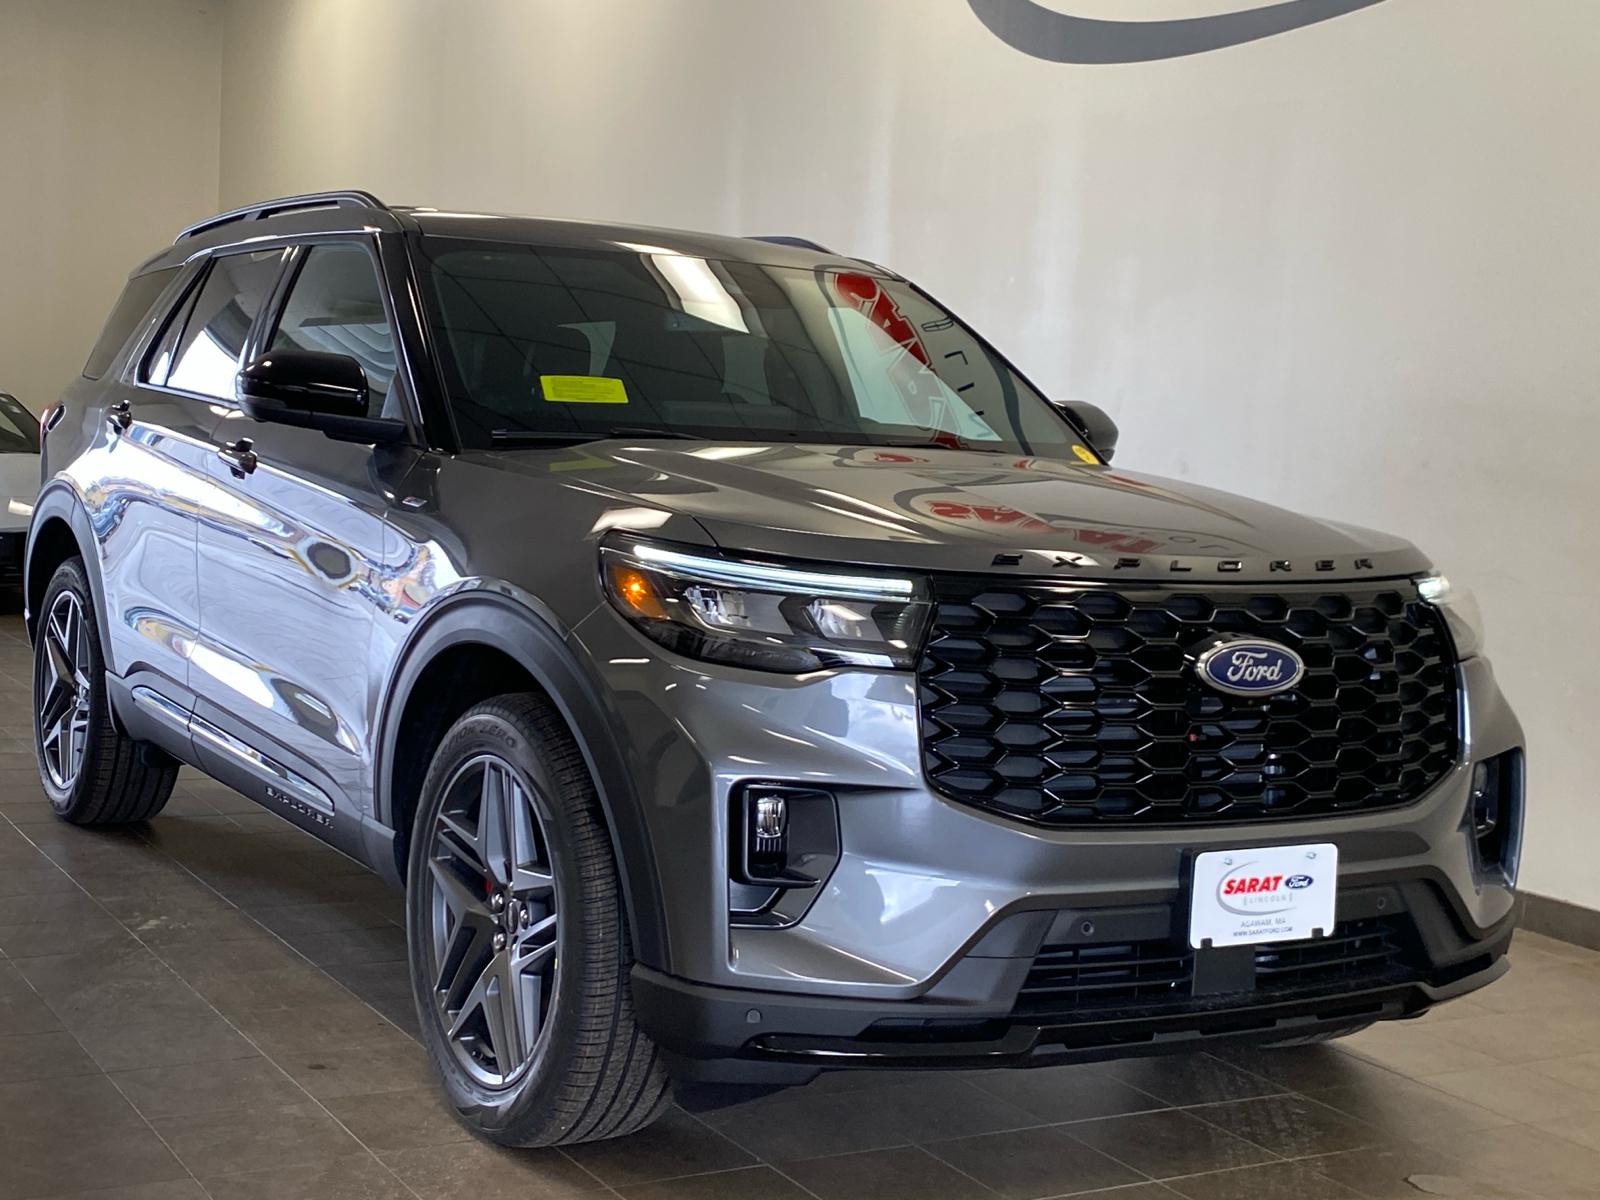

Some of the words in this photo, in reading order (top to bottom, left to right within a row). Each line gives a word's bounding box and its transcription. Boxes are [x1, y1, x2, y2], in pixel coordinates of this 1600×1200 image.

[991, 552, 1375, 573] EXPLORER
[1226, 650, 1283, 682] Ford
[1223, 875, 1284, 895] SARAT
[1289, 876, 1310, 888] Ford
[1249, 894, 1287, 904] LINCOLN
[1275, 917, 1287, 925] MA
